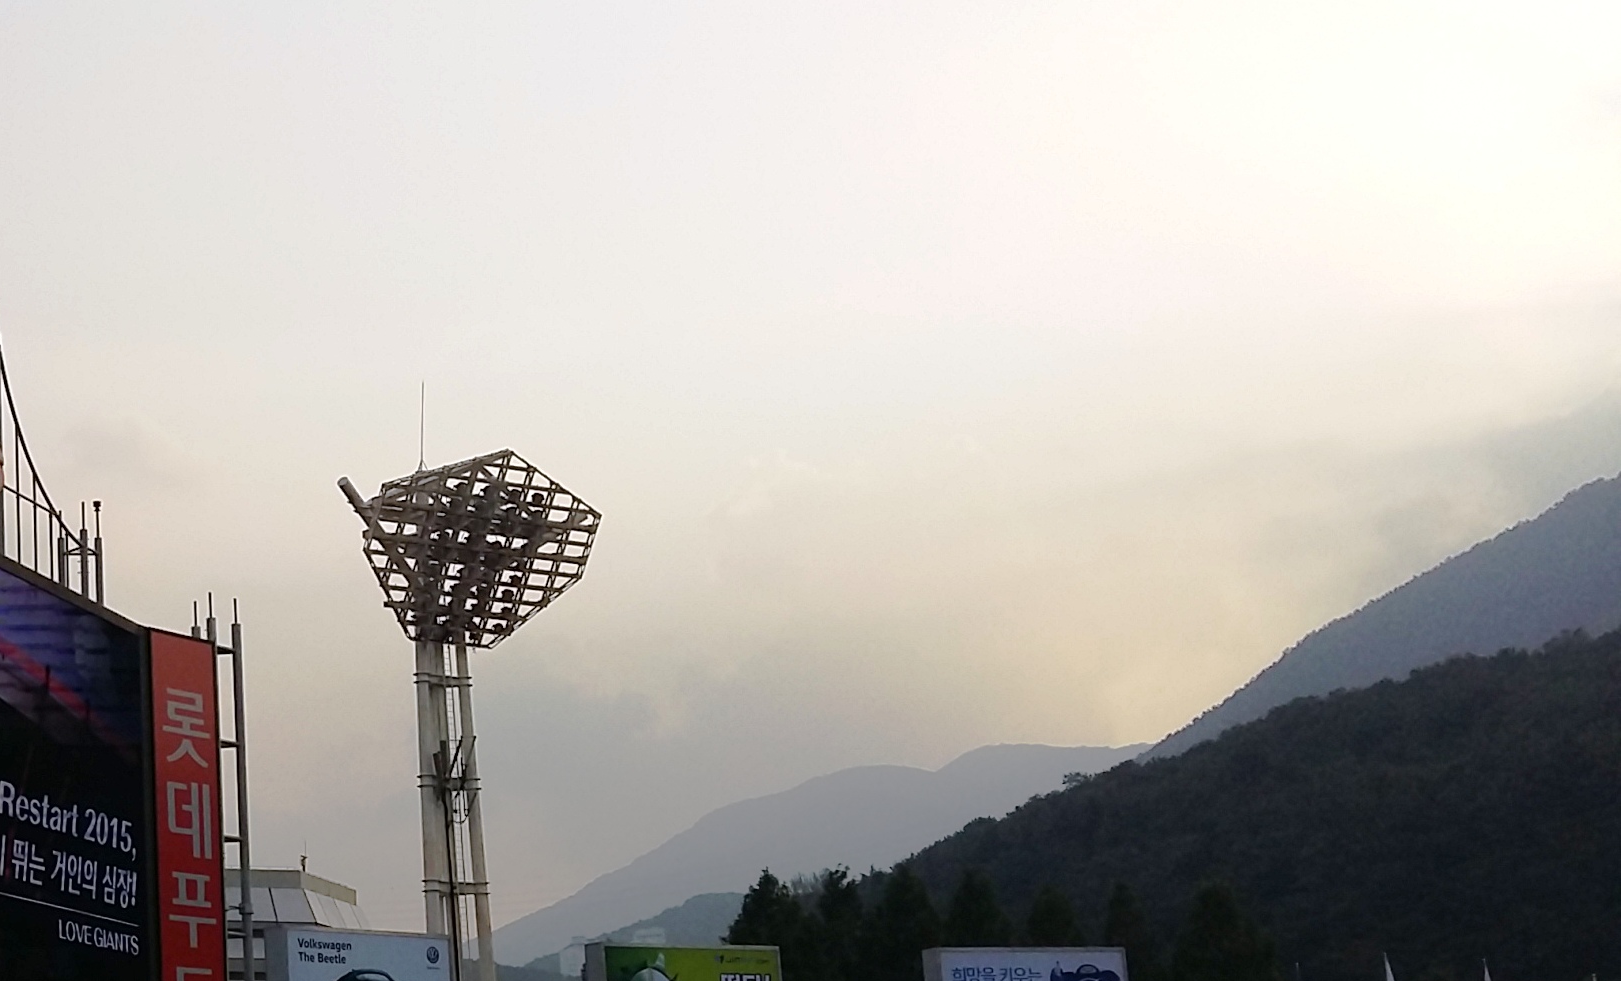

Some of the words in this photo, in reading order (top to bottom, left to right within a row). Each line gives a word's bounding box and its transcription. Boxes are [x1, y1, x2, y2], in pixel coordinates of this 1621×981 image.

[84, 808, 137, 862] 2015,
[11, 839, 46, 886] 뛰는
[50, 849, 98, 900] 거인의
[102, 865, 137, 909] 심장!
[58, 918, 92, 945] LOVE
[93, 927, 140, 956] GIANTS
[297, 938, 352, 952] Volkswagen
[298, 952, 315, 963] The
[317, 952, 347, 964] Beetle
